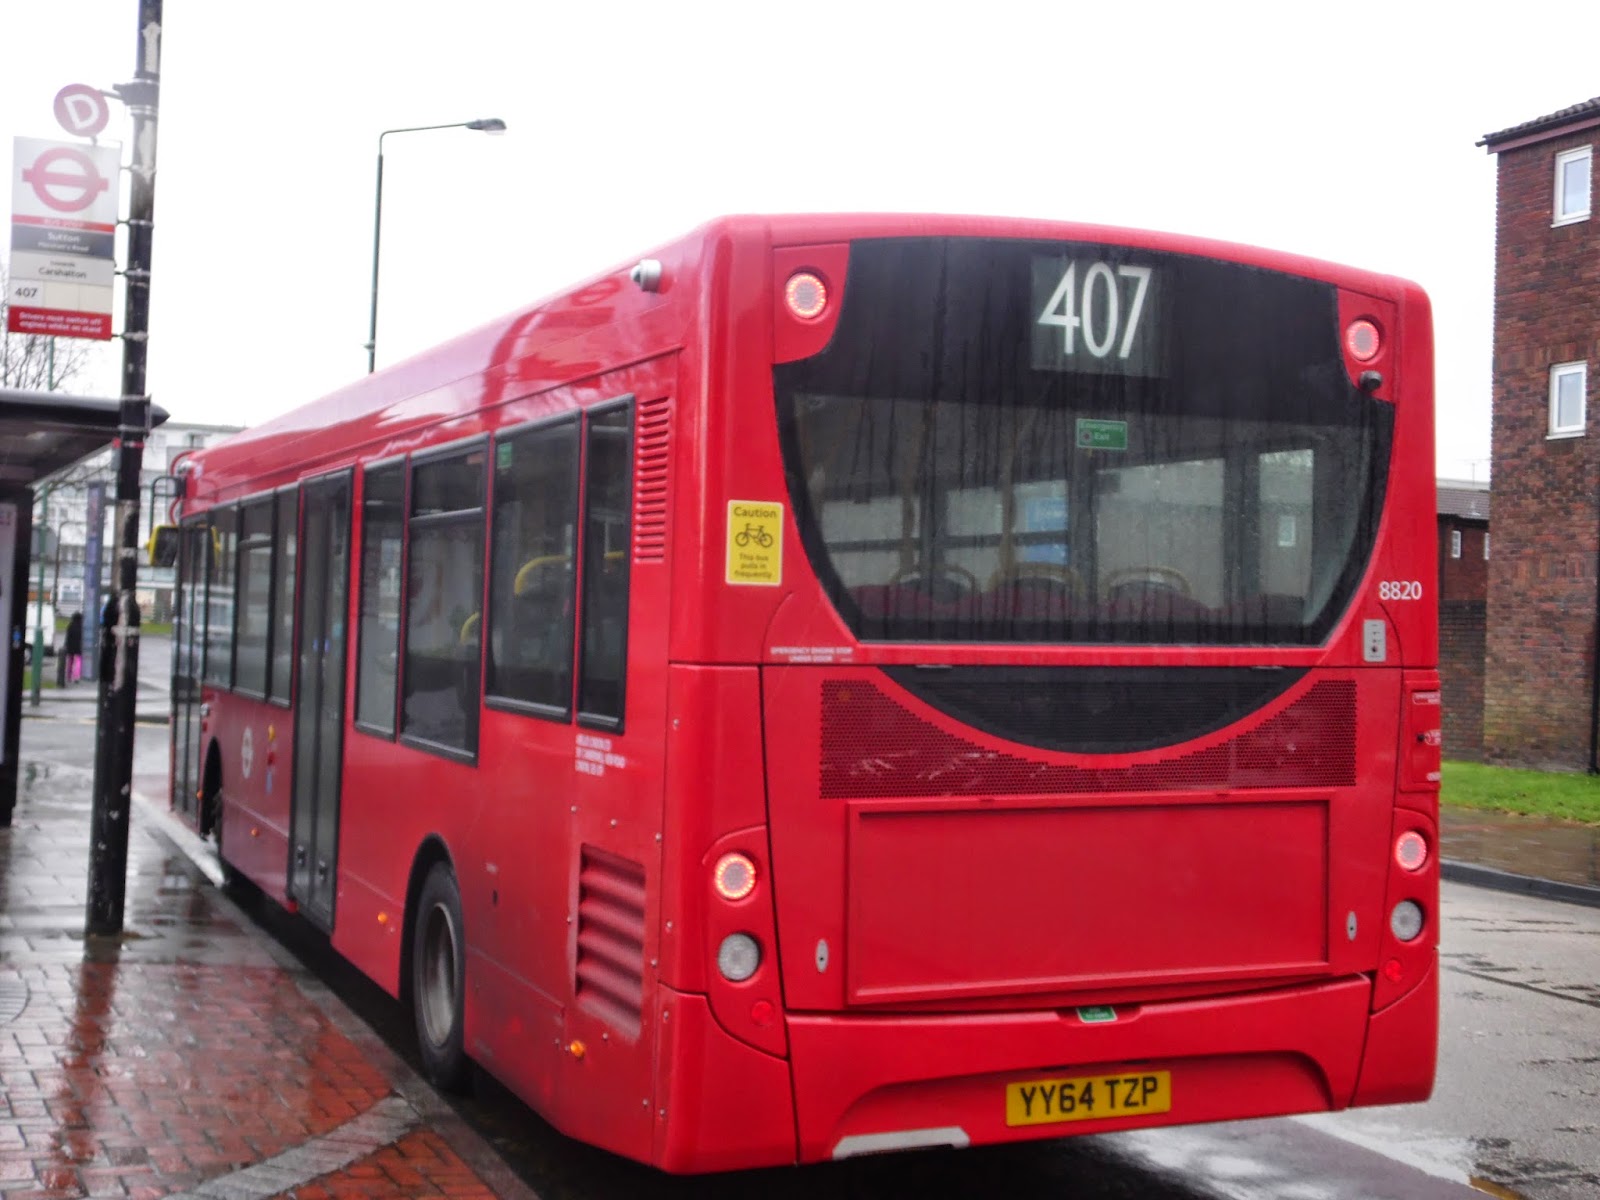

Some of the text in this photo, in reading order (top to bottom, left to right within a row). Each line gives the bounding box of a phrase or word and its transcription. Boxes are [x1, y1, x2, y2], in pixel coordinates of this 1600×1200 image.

[63, 93, 100, 130] D
[47, 232, 80, 243] Sutton
[39, 267, 86, 278] Carshalton
[15, 287, 37, 297] 407
[1038, 260, 1152, 359] 407
[733, 506, 777, 518] Caution
[734, 570, 773, 579] frequently
[1379, 581, 1422, 600] 8820
[1020, 1076, 1158, 1118] YY64 TZP
